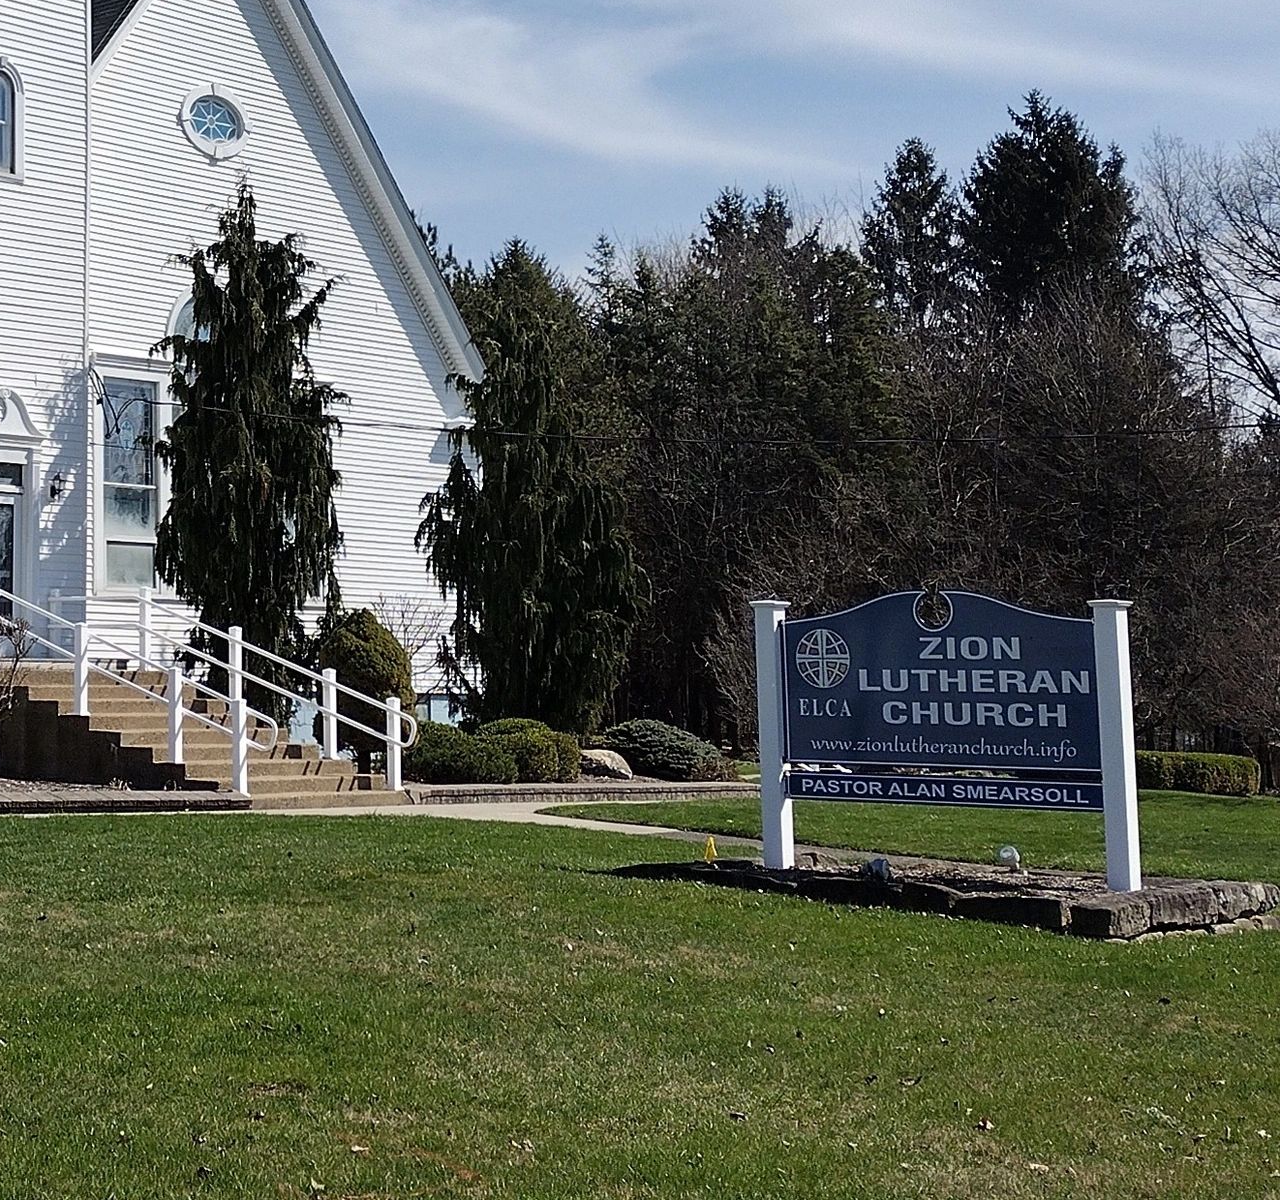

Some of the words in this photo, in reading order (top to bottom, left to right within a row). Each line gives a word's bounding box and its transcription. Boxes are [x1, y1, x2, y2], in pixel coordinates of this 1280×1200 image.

[919, 636, 1020, 660] ZION
[859, 668, 1090, 694] LUTHERAN
[800, 698, 852, 718] ELCA
[882, 702, 1067, 727] CHURCH
[810, 735, 1077, 762] www.zionlutheranchurch.info
[801, 778, 882, 796] PASTOR
[888, 782, 945, 799] ALAN
[952, 785, 1089, 803] SMEARSOLL
